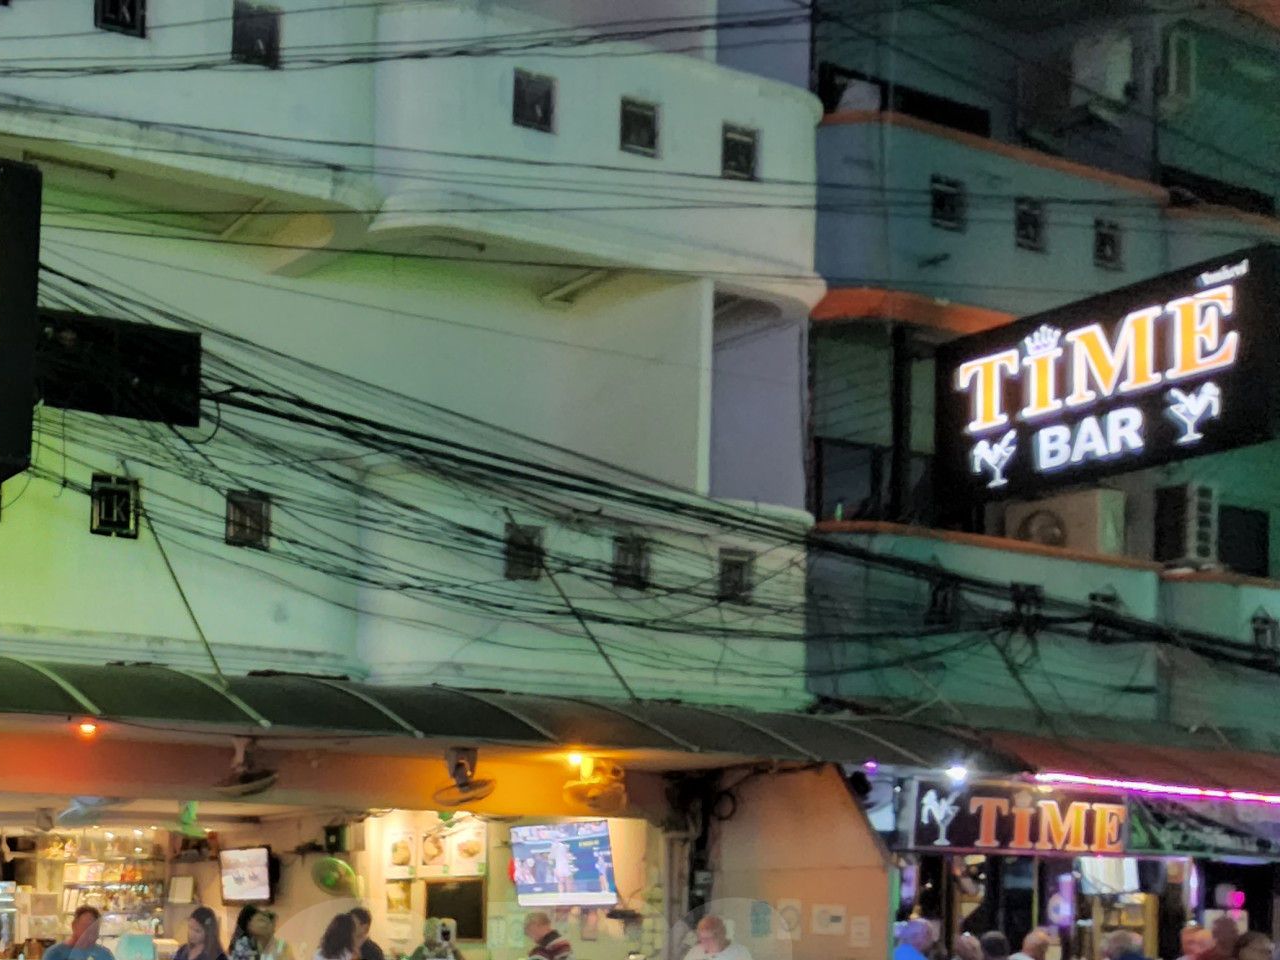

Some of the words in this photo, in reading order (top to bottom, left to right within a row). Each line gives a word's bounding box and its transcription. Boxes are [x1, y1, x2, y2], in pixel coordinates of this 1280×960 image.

[958, 284, 1239, 432] TIME
[1038, 406, 1144, 471] BAR
[970, 796, 1128, 853] TIME
